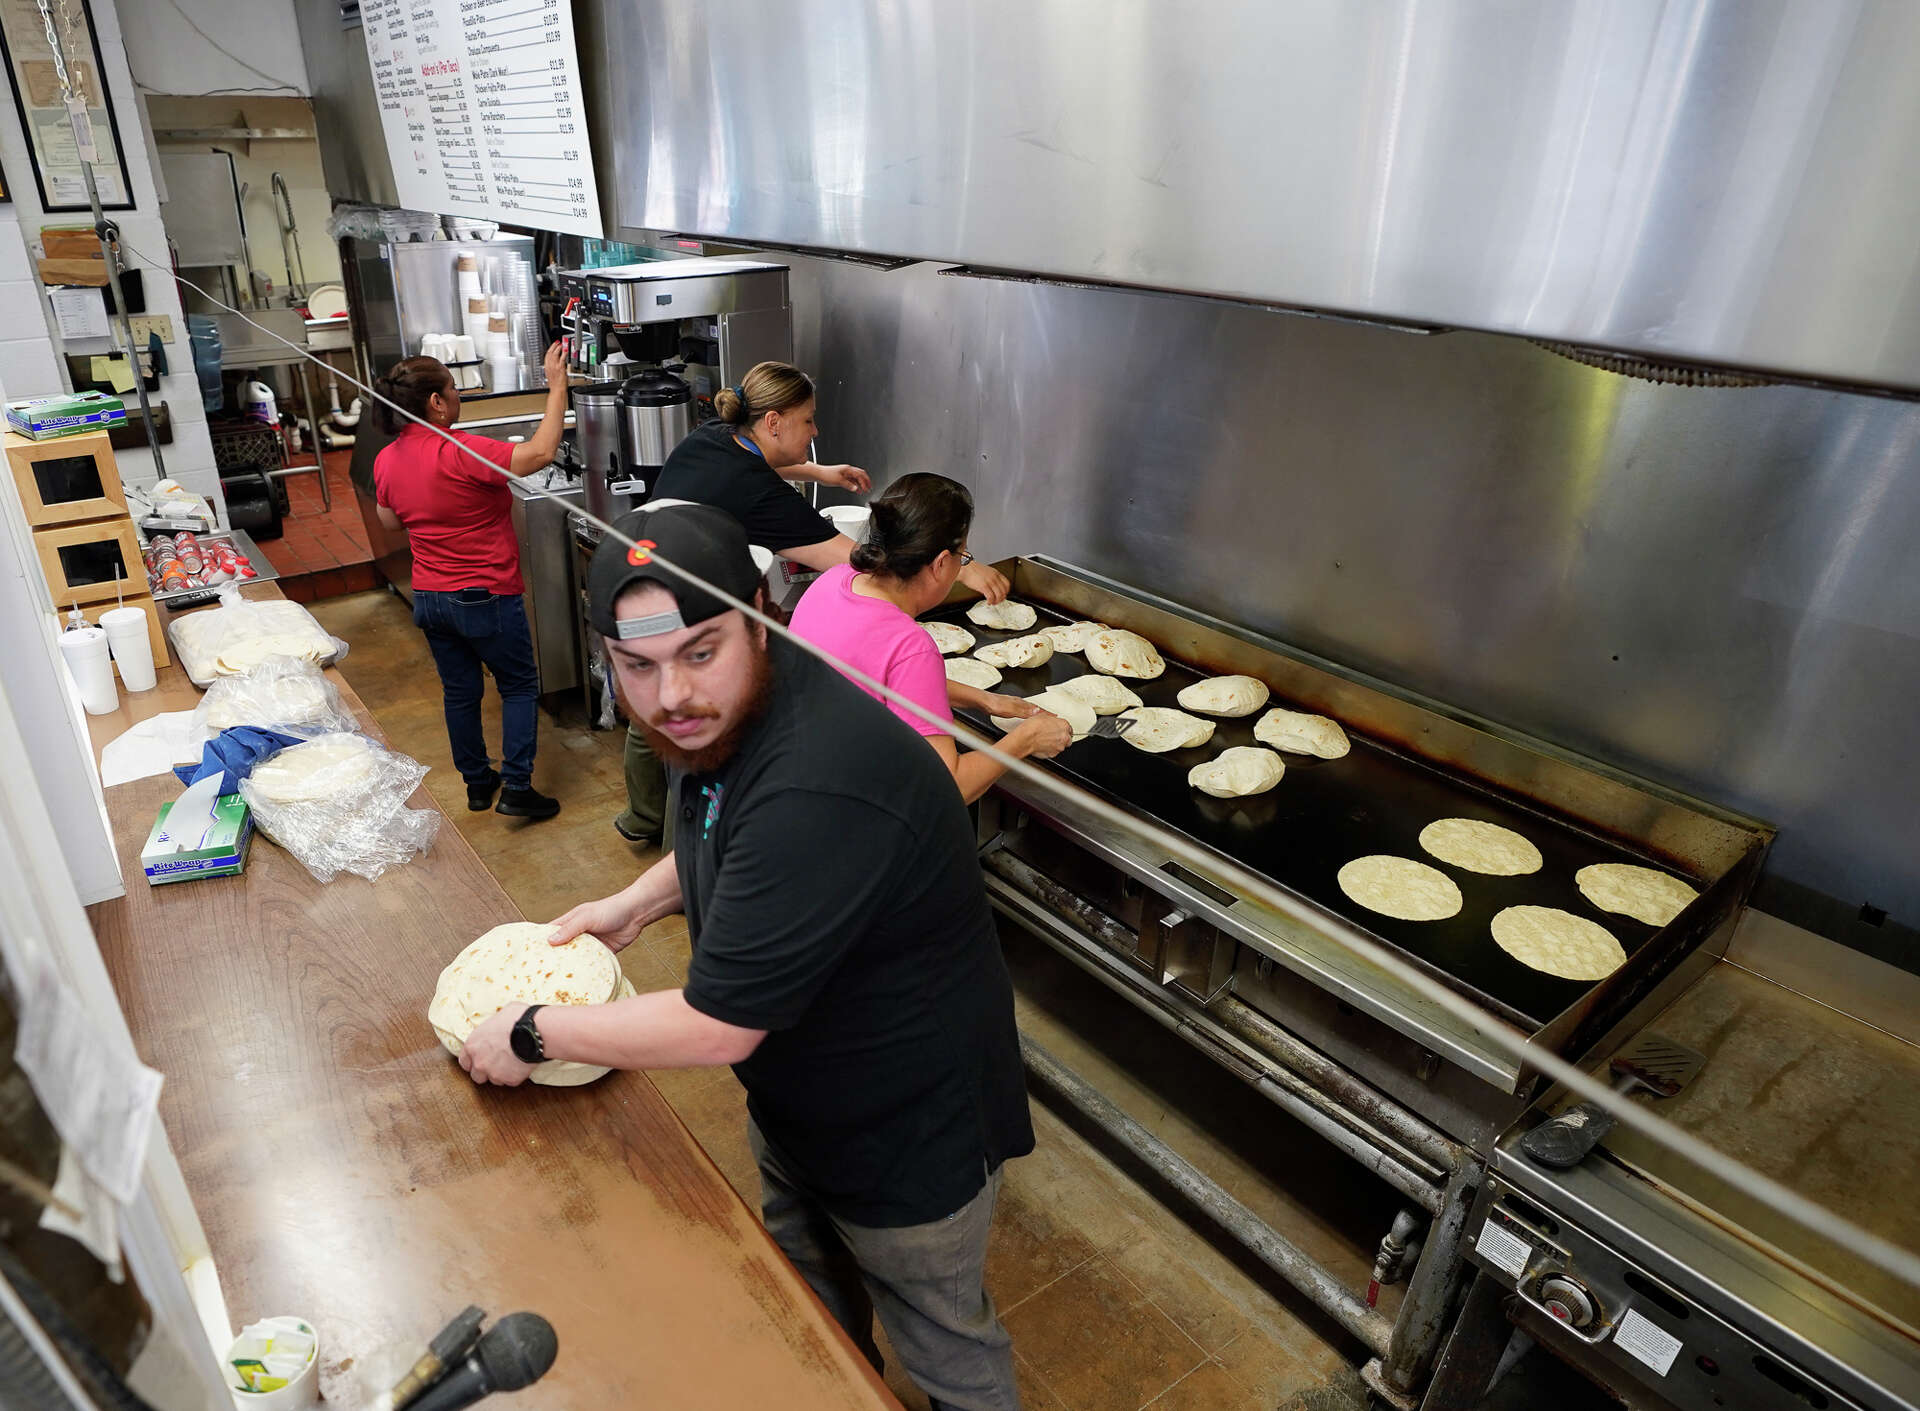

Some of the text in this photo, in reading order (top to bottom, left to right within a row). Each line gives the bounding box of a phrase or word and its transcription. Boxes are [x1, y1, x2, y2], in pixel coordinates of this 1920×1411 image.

[544, 13, 558, 25] $10.99
[546, 31, 560, 42] $10.99
[550, 59, 564, 70] $11.99
[552, 75, 566, 86] $11.99
[555, 91, 569, 102] $11.99
[557, 108, 571, 118] $11.99
[559, 124, 574, 134] $11.99
[564, 151, 578, 160] $11.99
[568, 178, 583, 188] $14.99
[570, 193, 585, 203] $14.99
[573, 208, 587, 218] $14.99
